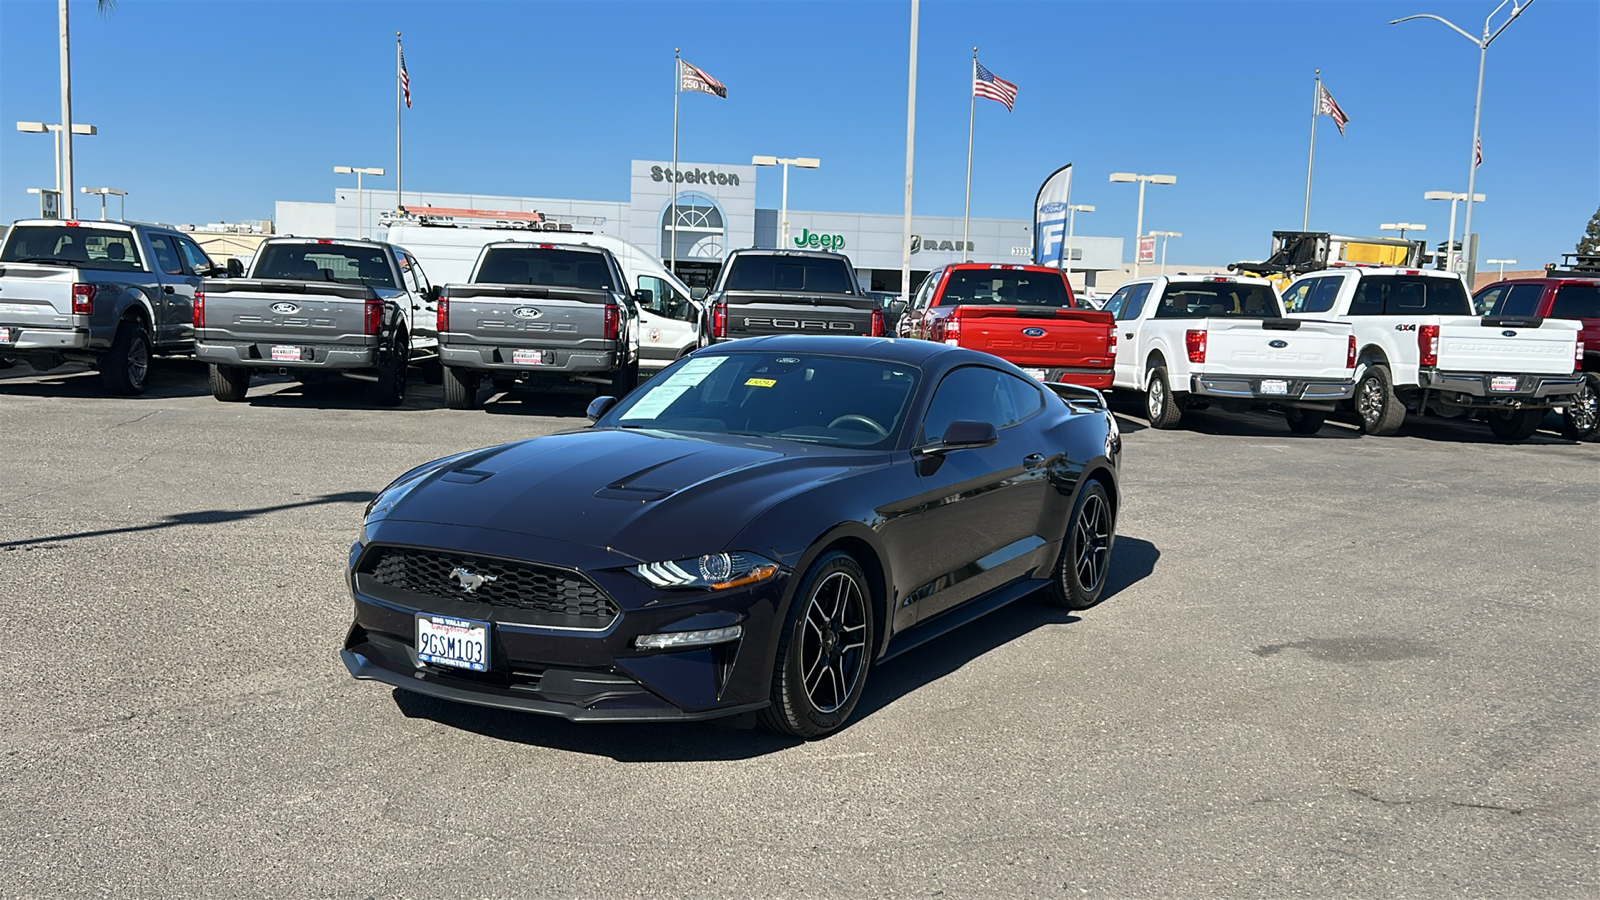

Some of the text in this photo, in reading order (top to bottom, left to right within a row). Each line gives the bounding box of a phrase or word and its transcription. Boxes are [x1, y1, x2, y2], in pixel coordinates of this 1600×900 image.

[682, 80, 699, 89] 250
[650, 165, 740, 187] Stockton
[1044, 203, 1064, 213] Ford
[794, 228, 845, 250] Jeep
[923, 239, 975, 252] RAM
[1012, 247, 1029, 256] 3333
[233, 315, 337, 329] F-150
[476, 319, 578, 333] F-150
[743, 317, 855, 331] FORD
[986, 340, 1081, 352] F-150
[1448, 343, 1567, 354] SUPER DUTY
[1231, 350, 1323, 363] F-150
[431, 616, 470, 628] BIG VALLEY
[421, 632, 482, 663] 9GSM103
[431, 656, 471, 668] STOCKTON
